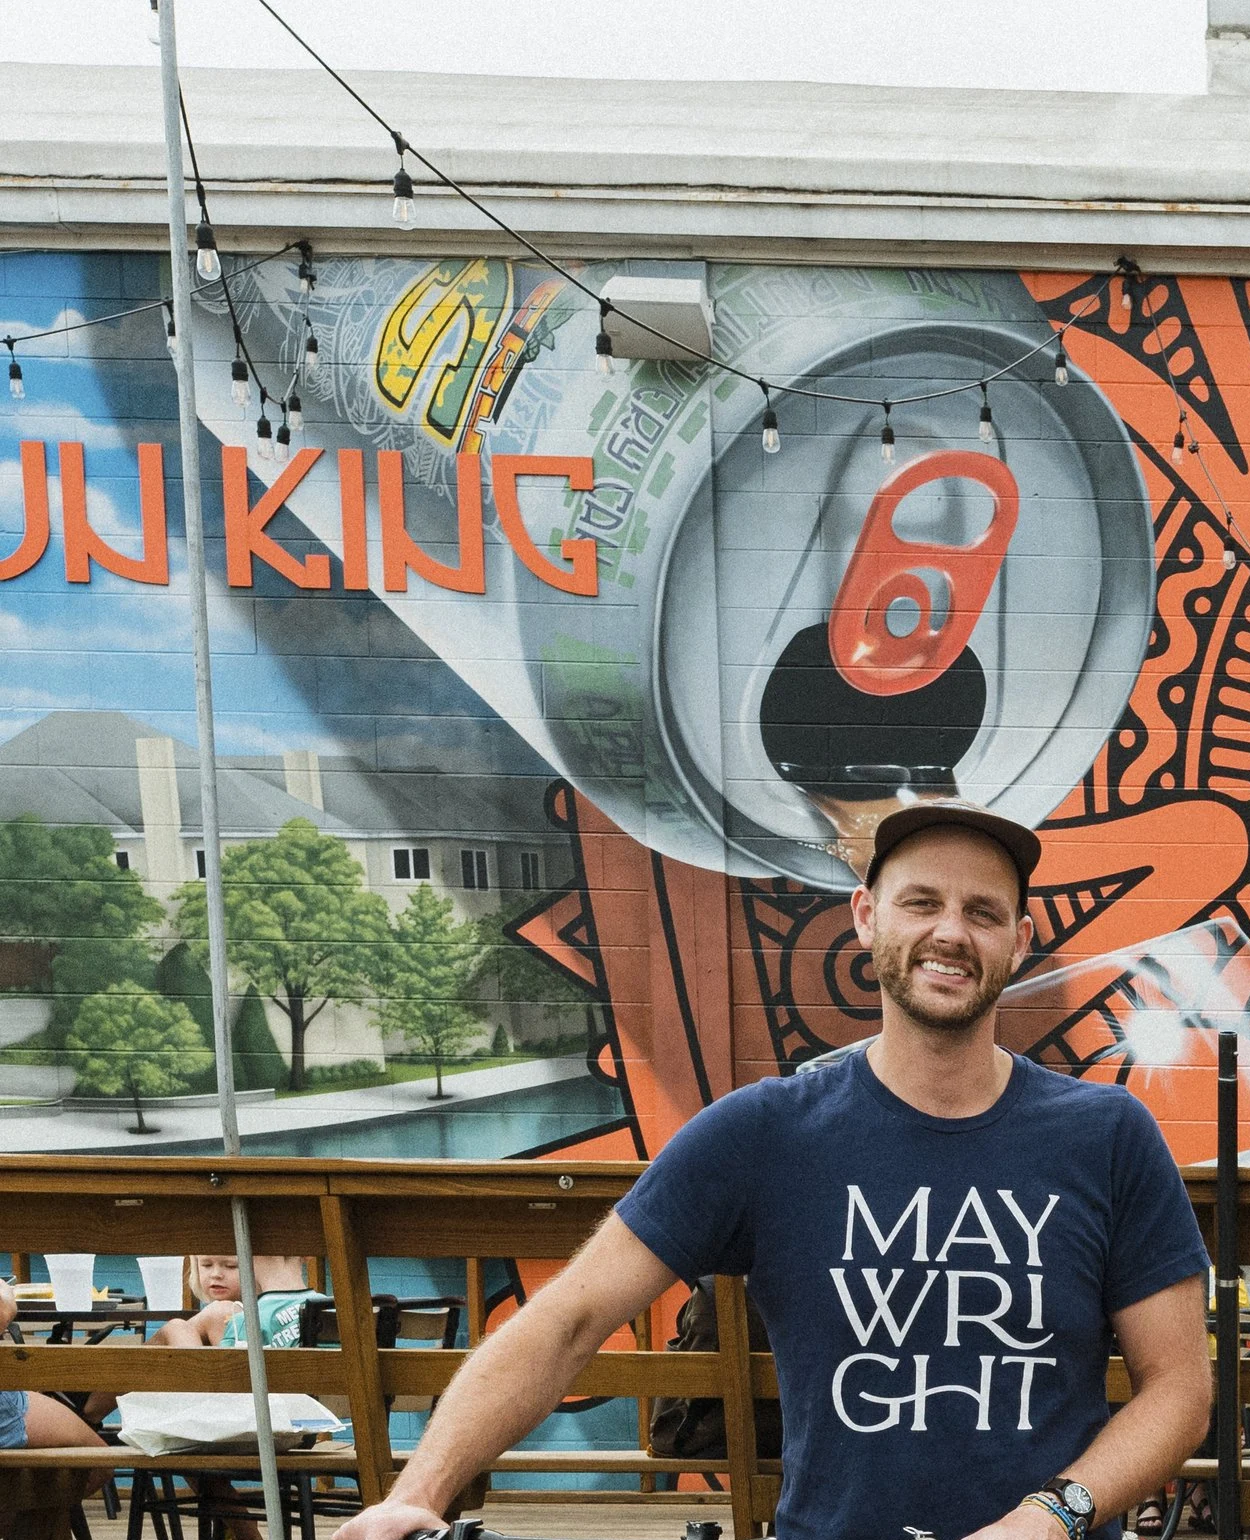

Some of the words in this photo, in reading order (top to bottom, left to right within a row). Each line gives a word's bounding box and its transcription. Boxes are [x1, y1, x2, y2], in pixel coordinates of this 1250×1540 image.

[222, 447, 598, 597] KING
[841, 1184, 1060, 1266] MAY
[829, 1267, 1054, 1350] WRI
[831, 1352, 1057, 1433] GHT
